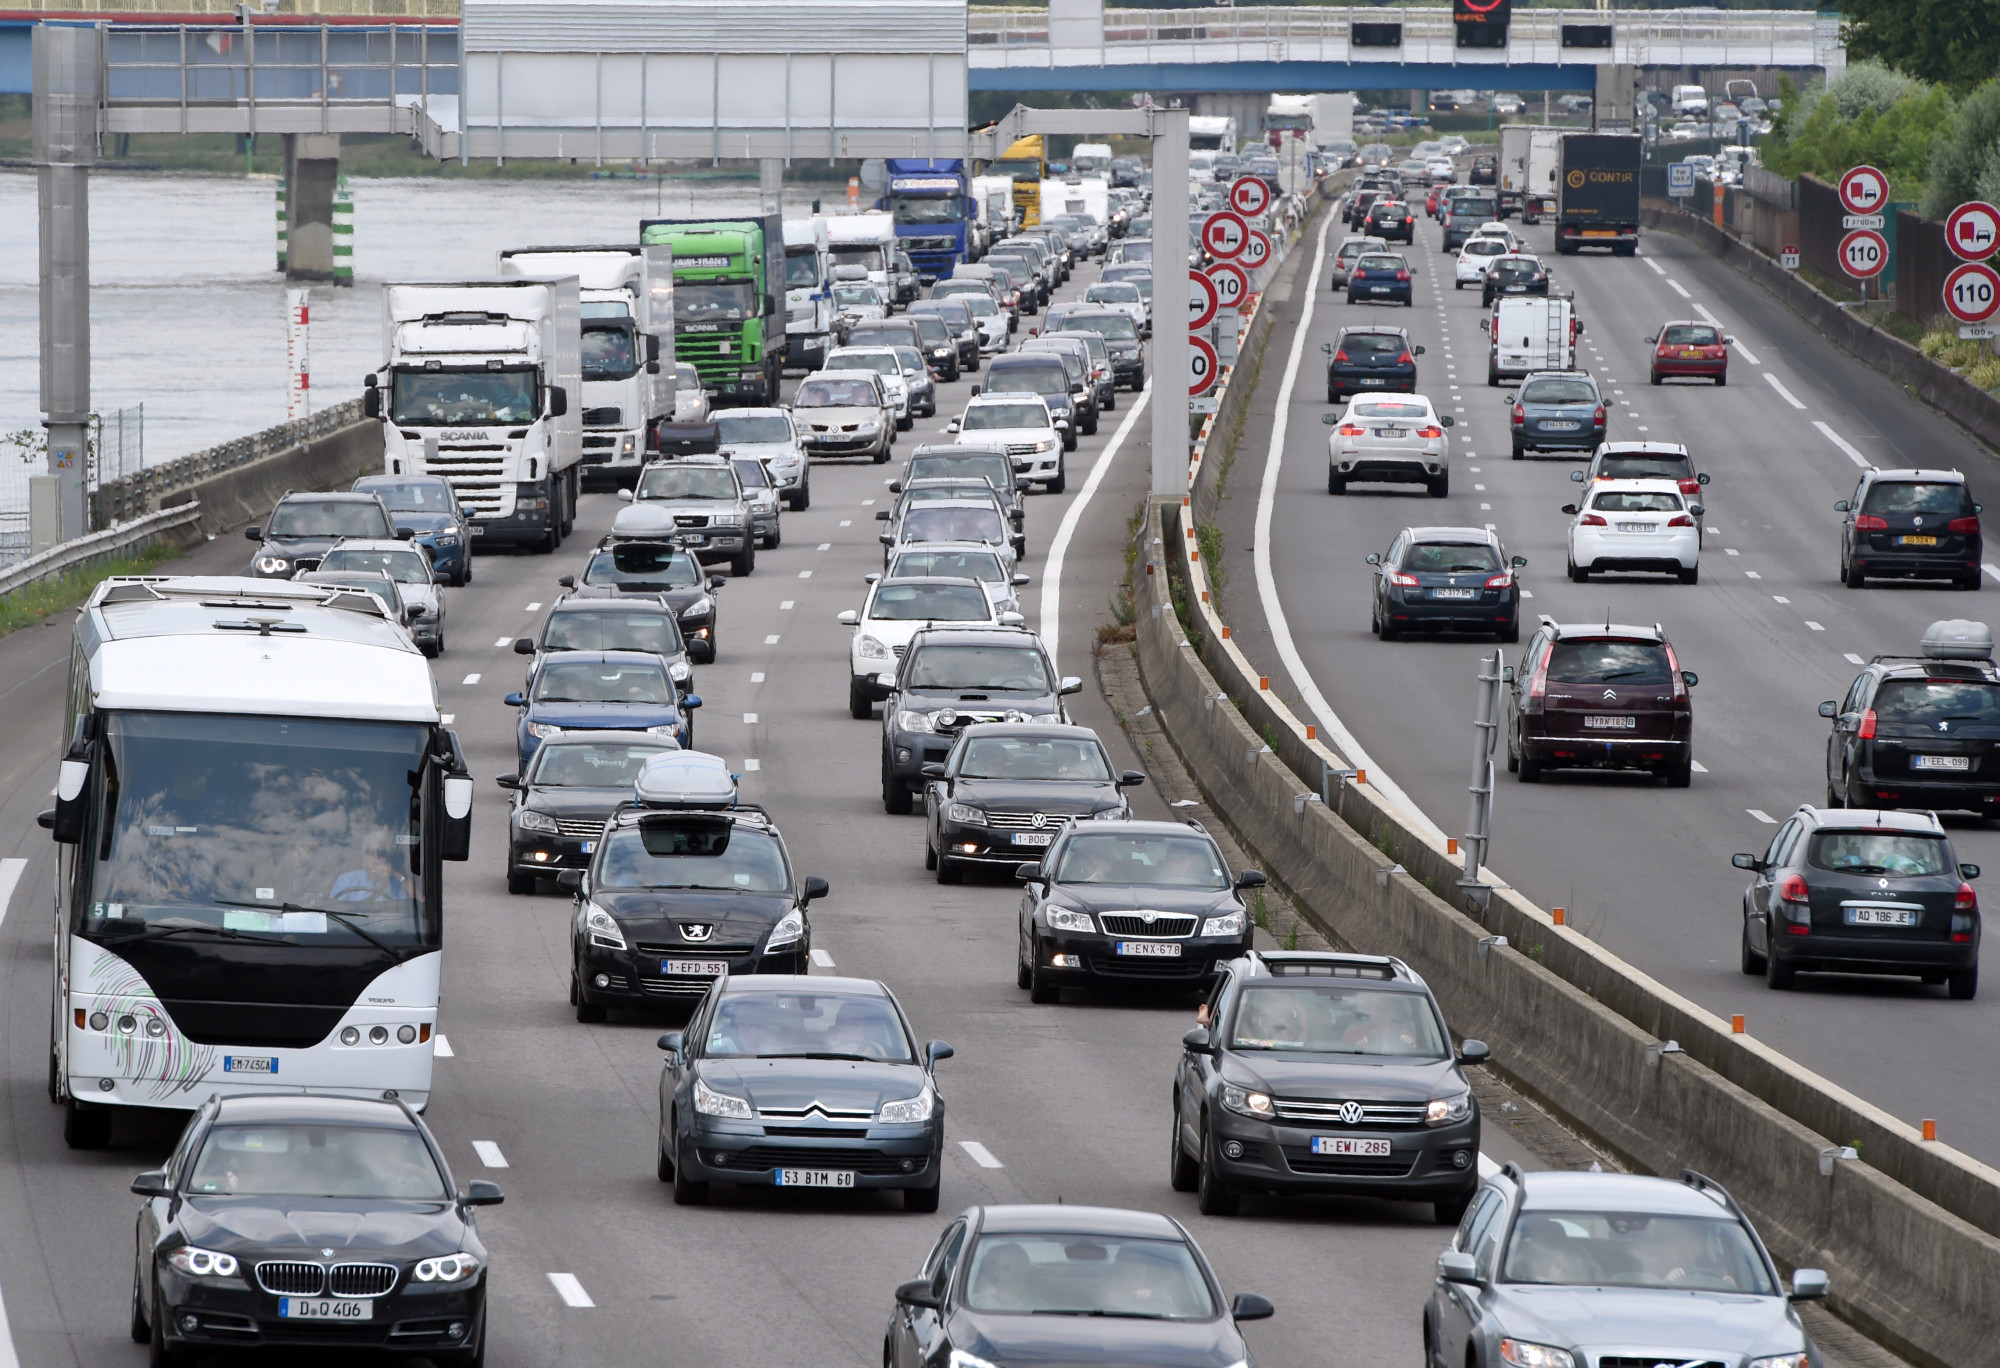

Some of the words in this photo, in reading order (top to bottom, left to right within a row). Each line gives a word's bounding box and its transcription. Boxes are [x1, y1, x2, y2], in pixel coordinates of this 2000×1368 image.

[1848, 246, 1878, 262] 110
[1955, 283, 1992, 303] 110
[684, 324, 719, 333] SCANIA
[440, 431, 490, 441] SCANIA
[94, 901, 104, 918] 5
[1125, 943, 1180, 955] 1-ENX-678
[669, 962, 726, 974] 1-EFD-551
[1322, 1140, 1388, 1154] 1-EWI-285
[784, 1170, 799, 1184] 53
[805, 1171, 829, 1186] BTM
[837, 1172, 852, 1186] 60
[332, 1302, 361, 1317] 406
